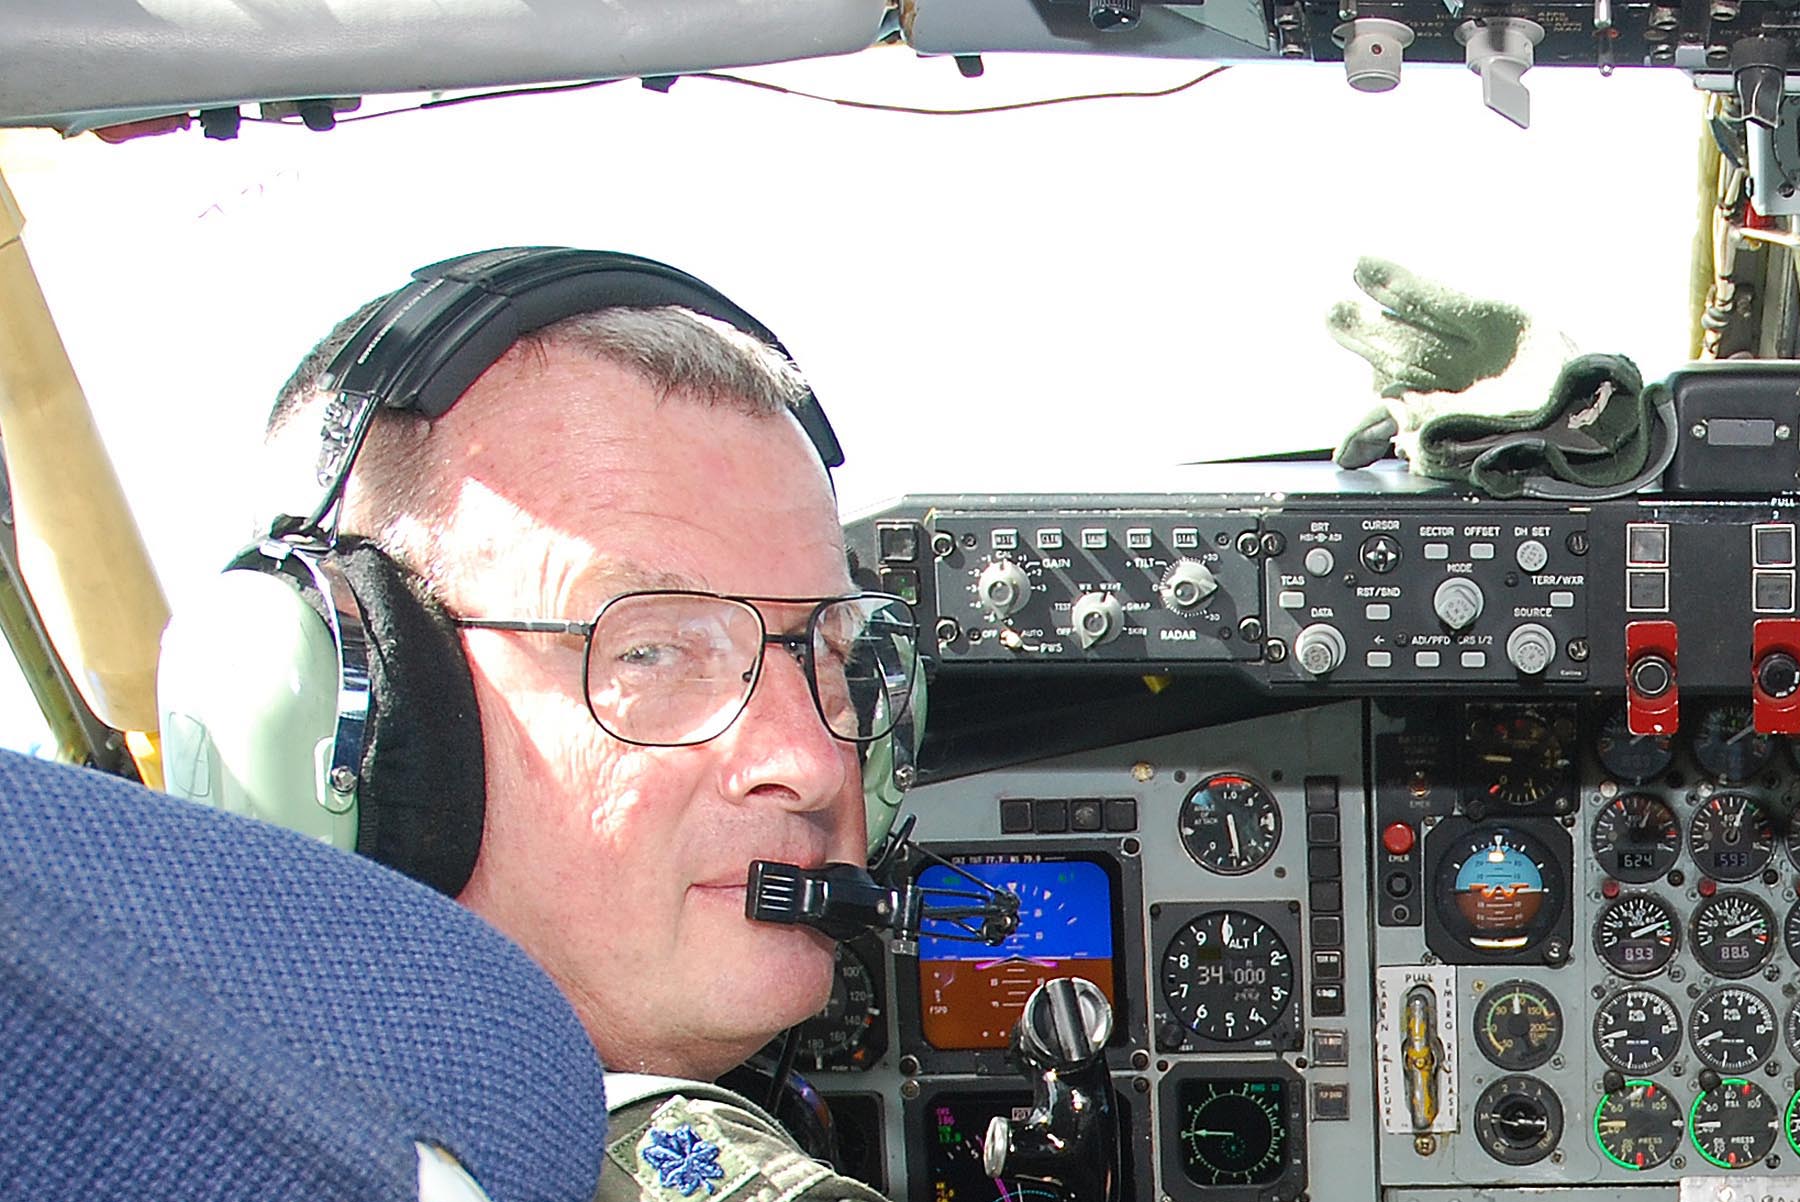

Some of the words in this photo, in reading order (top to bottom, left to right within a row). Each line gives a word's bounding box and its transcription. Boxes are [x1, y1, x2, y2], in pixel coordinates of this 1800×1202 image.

[1771, 498, 1796, 508] PULL
[1310, 522, 1329, 532] BRT
[1362, 521, 1400, 531] CURSOR
[1420, 527, 1454, 537] SECTOR
[1465, 527, 1500, 537] OFFSET
[1514, 527, 1529, 537] DH
[1532, 527, 1550, 537] SET
[1043, 559, 1070, 569] GAIN
[1134, 559, 1155, 569] TILT
[1448, 563, 1472, 573] MODE
[1280, 576, 1304, 585] TCAS
[1531, 576, 1584, 586] TERR/WXR
[1311, 608, 1334, 618] DATA
[1514, 608, 1552, 618] SOURCE
[1021, 629, 1043, 638] AUTO
[1161, 630, 1196, 641] RADAR
[1412, 636, 1450, 645] ADI/PFD
[1623, 852, 1653, 869] 624
[1719, 852, 1748, 868] 593
[1196, 930, 1207, 946] 9
[1229, 937, 1250, 950] ALT
[1179, 955, 1189, 969] 8
[1270, 951, 1281, 965] 2
[1197, 966, 1224, 985] 34
[1233, 967, 1266, 986] 000
[1405, 973, 1434, 983] PULL
[1179, 984, 1188, 998] 7
[1271, 986, 1282, 1001] 3
[1444, 978, 1453, 1031] EMERG
[1197, 1005, 1208, 1019] 6
[1225, 1012, 1235, 1027] 5
[1249, 1008, 1259, 1022] 4
[1446, 1042, 1455, 1117] RELEASE
